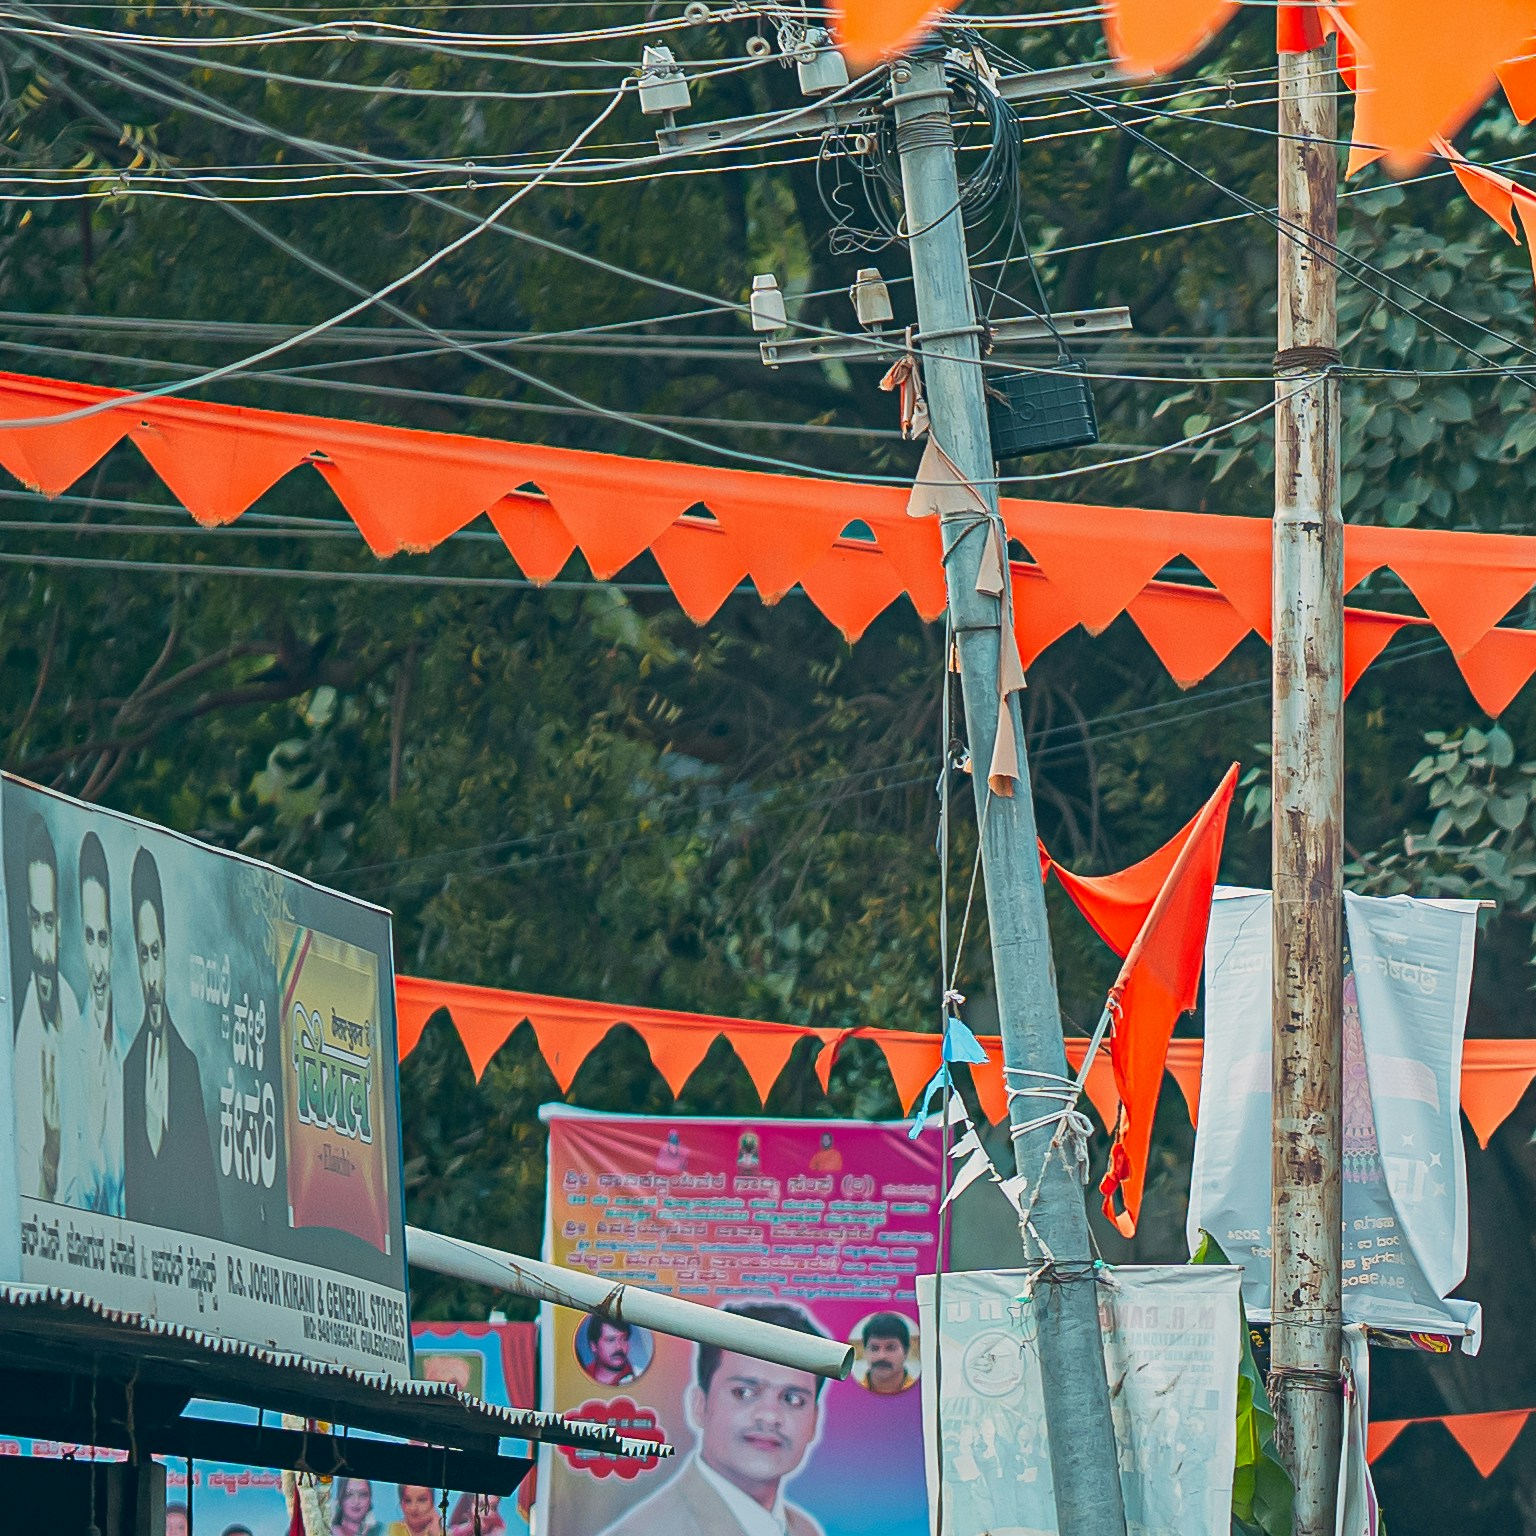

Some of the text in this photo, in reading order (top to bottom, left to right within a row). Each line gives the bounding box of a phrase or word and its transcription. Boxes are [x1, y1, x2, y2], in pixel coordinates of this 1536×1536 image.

[221, 1067, 276, 1188] ಕೇಸರಿ
[292, 1001, 373, 1144] विमल
[227, 1256, 405, 1339] R.S. JOGUR KIRANI & GENERAL STORES
